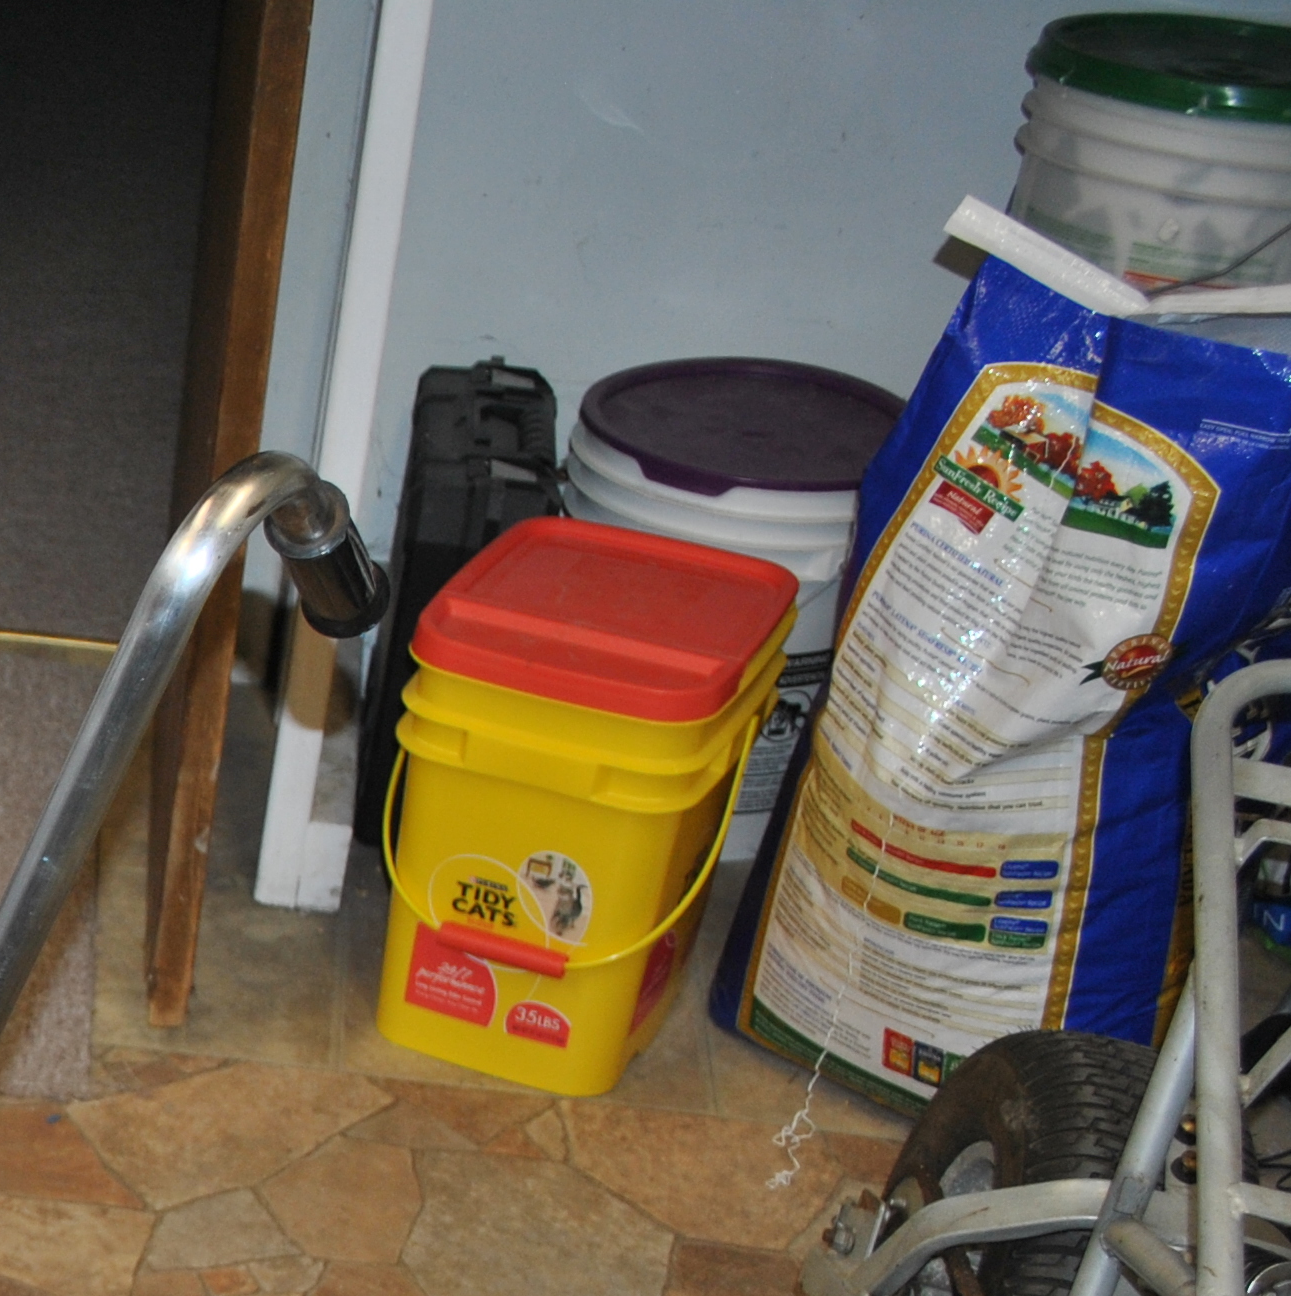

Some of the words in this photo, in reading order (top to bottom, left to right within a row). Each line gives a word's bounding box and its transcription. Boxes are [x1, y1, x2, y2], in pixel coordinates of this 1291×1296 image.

[935, 456, 982, 494] SunFresh
[982, 488, 1018, 517] Recipe
[946, 489, 983, 515] Natural
[1103, 649, 1169, 673] Natural
[457, 881, 516, 910] TIDY
[452, 897, 515, 926] CATS
